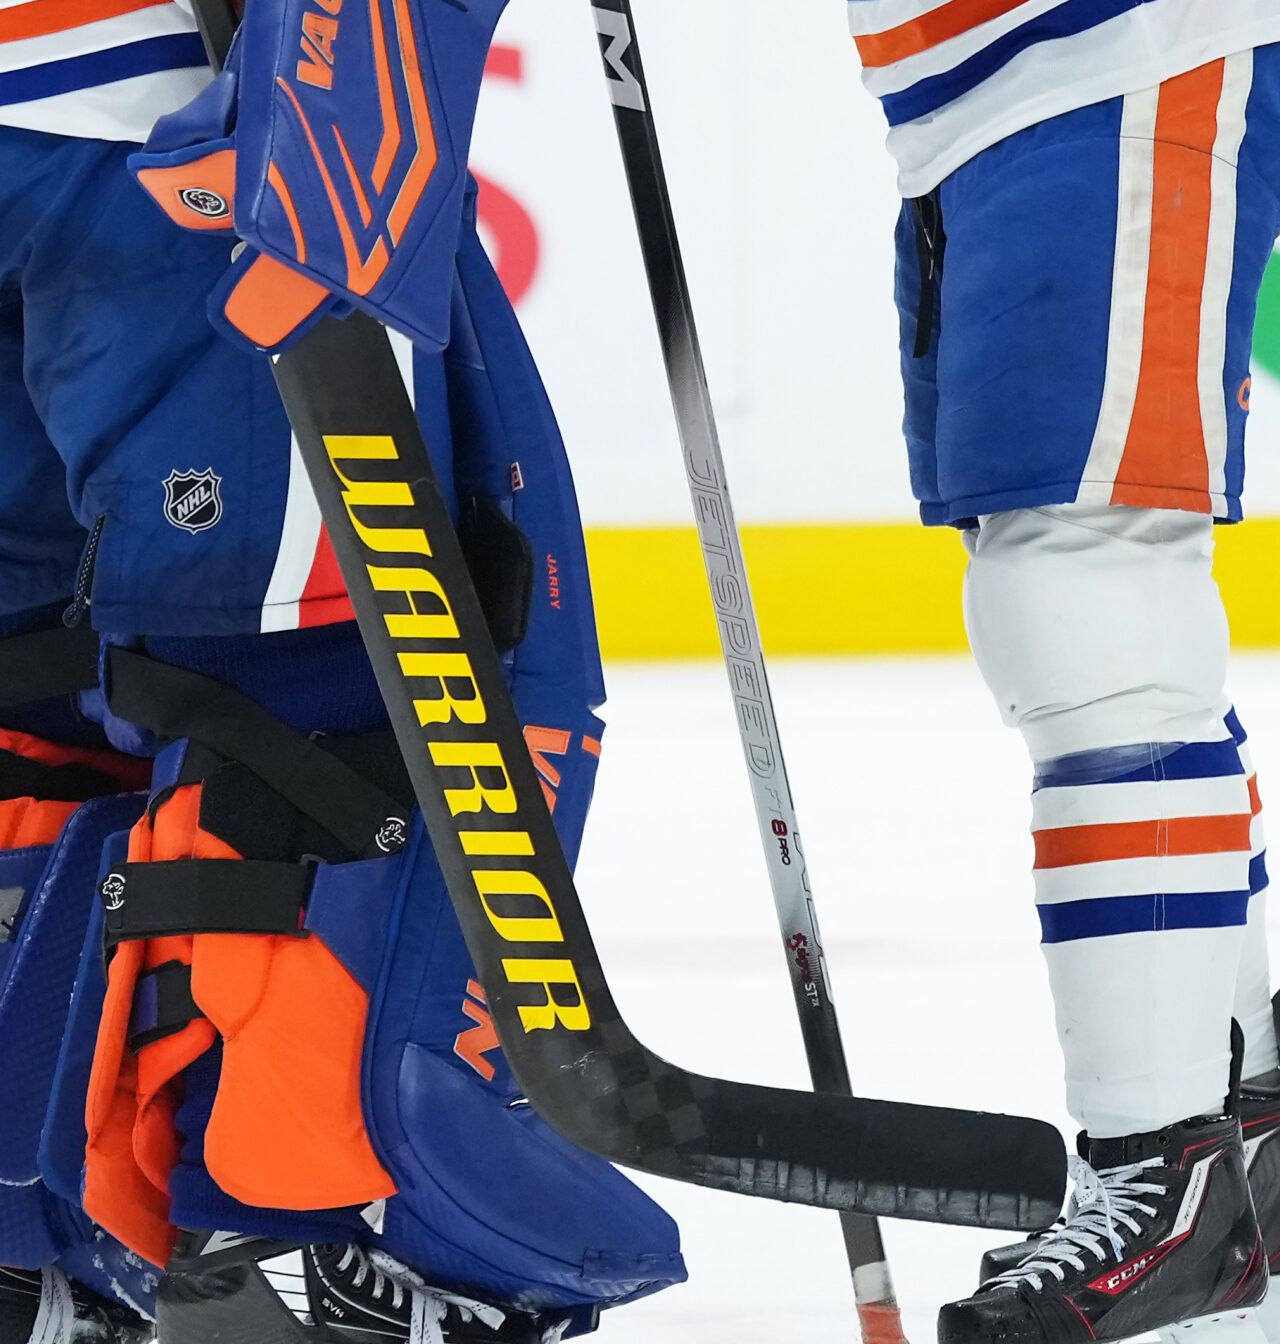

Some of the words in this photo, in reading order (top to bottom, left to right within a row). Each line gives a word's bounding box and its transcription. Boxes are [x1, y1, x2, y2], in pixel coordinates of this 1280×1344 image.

[176, 485, 211, 519] NHL
[546, 554, 561, 610] JARRY
[689, 450, 777, 780] JETSPEED
[777, 837, 791, 866] PRO
[320, 433, 593, 1035] WARRIOR
[1183, 1167, 1202, 1224] JETSPEED
[1106, 1257, 1147, 1290] CCM
